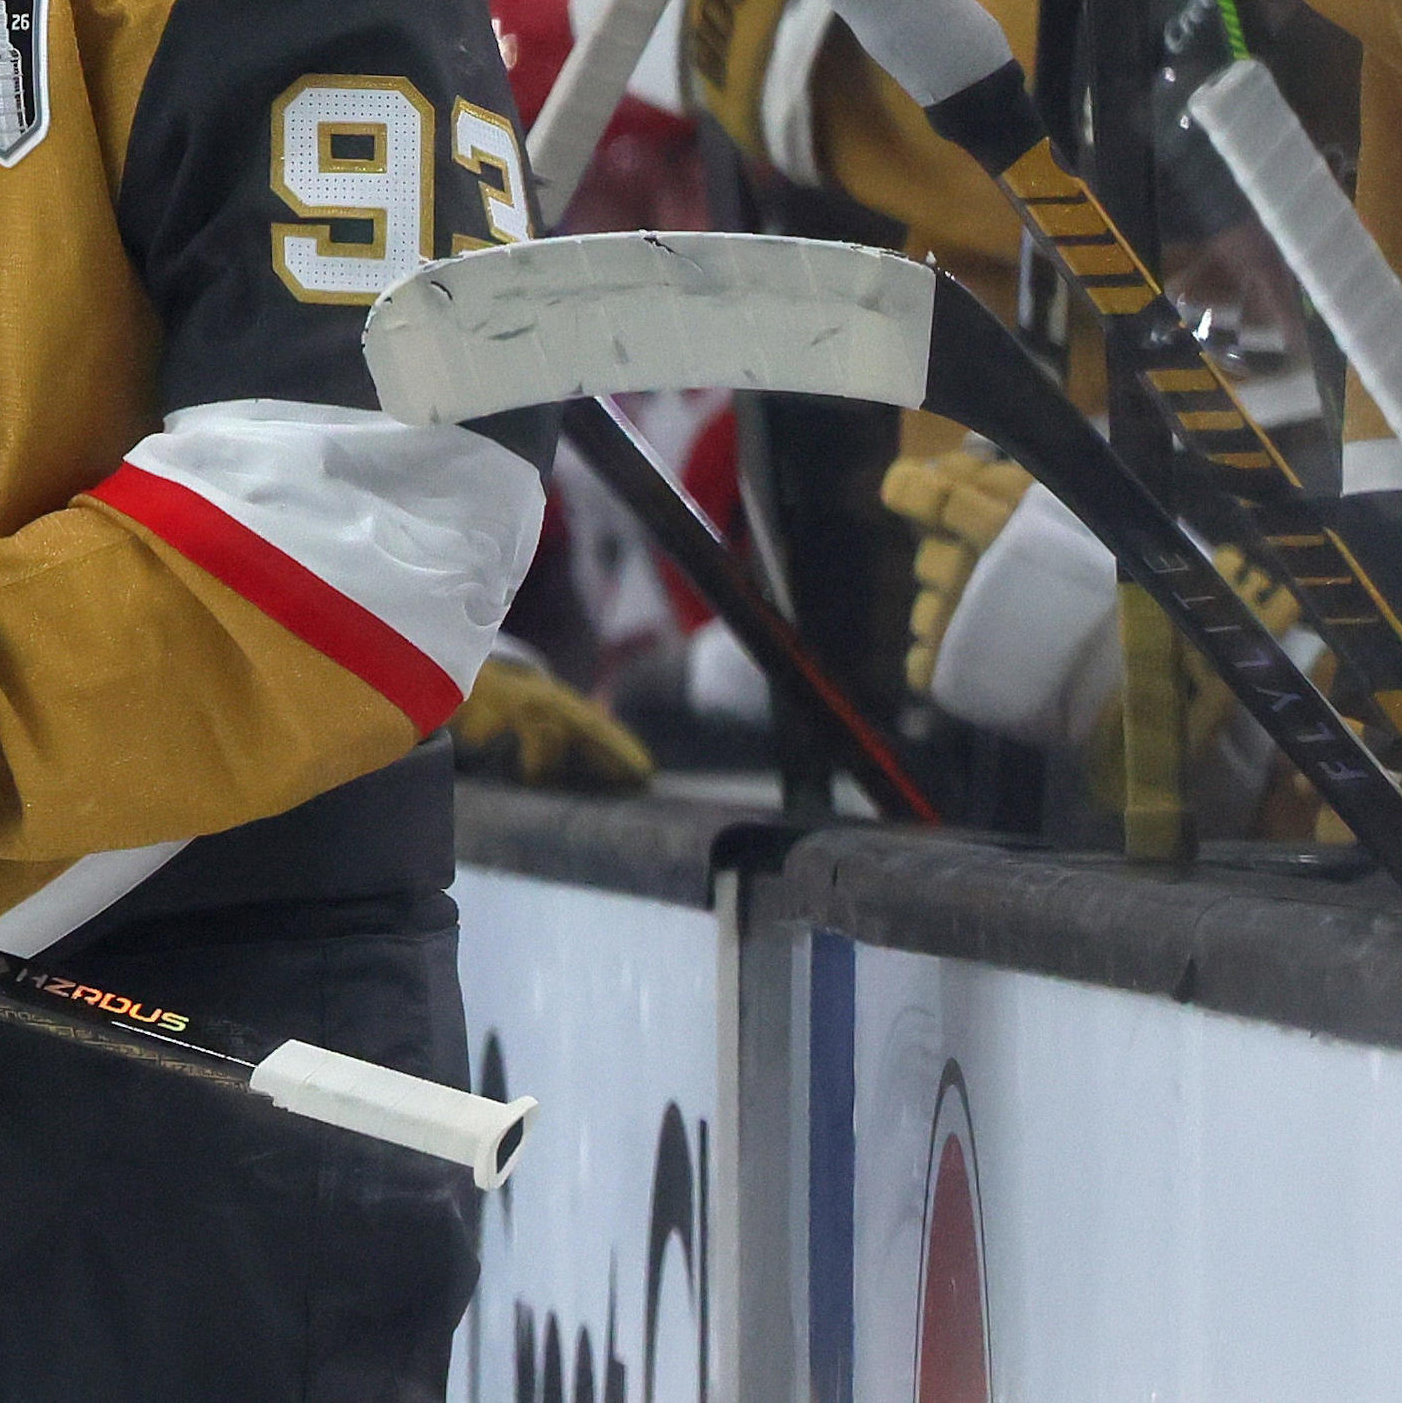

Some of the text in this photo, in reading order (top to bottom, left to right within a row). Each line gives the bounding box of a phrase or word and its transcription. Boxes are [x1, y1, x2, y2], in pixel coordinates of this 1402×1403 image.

[11, 13, 30, 31] 26
[269, 73, 534, 306] 93
[16, 967, 190, 1033] HZRDUS
